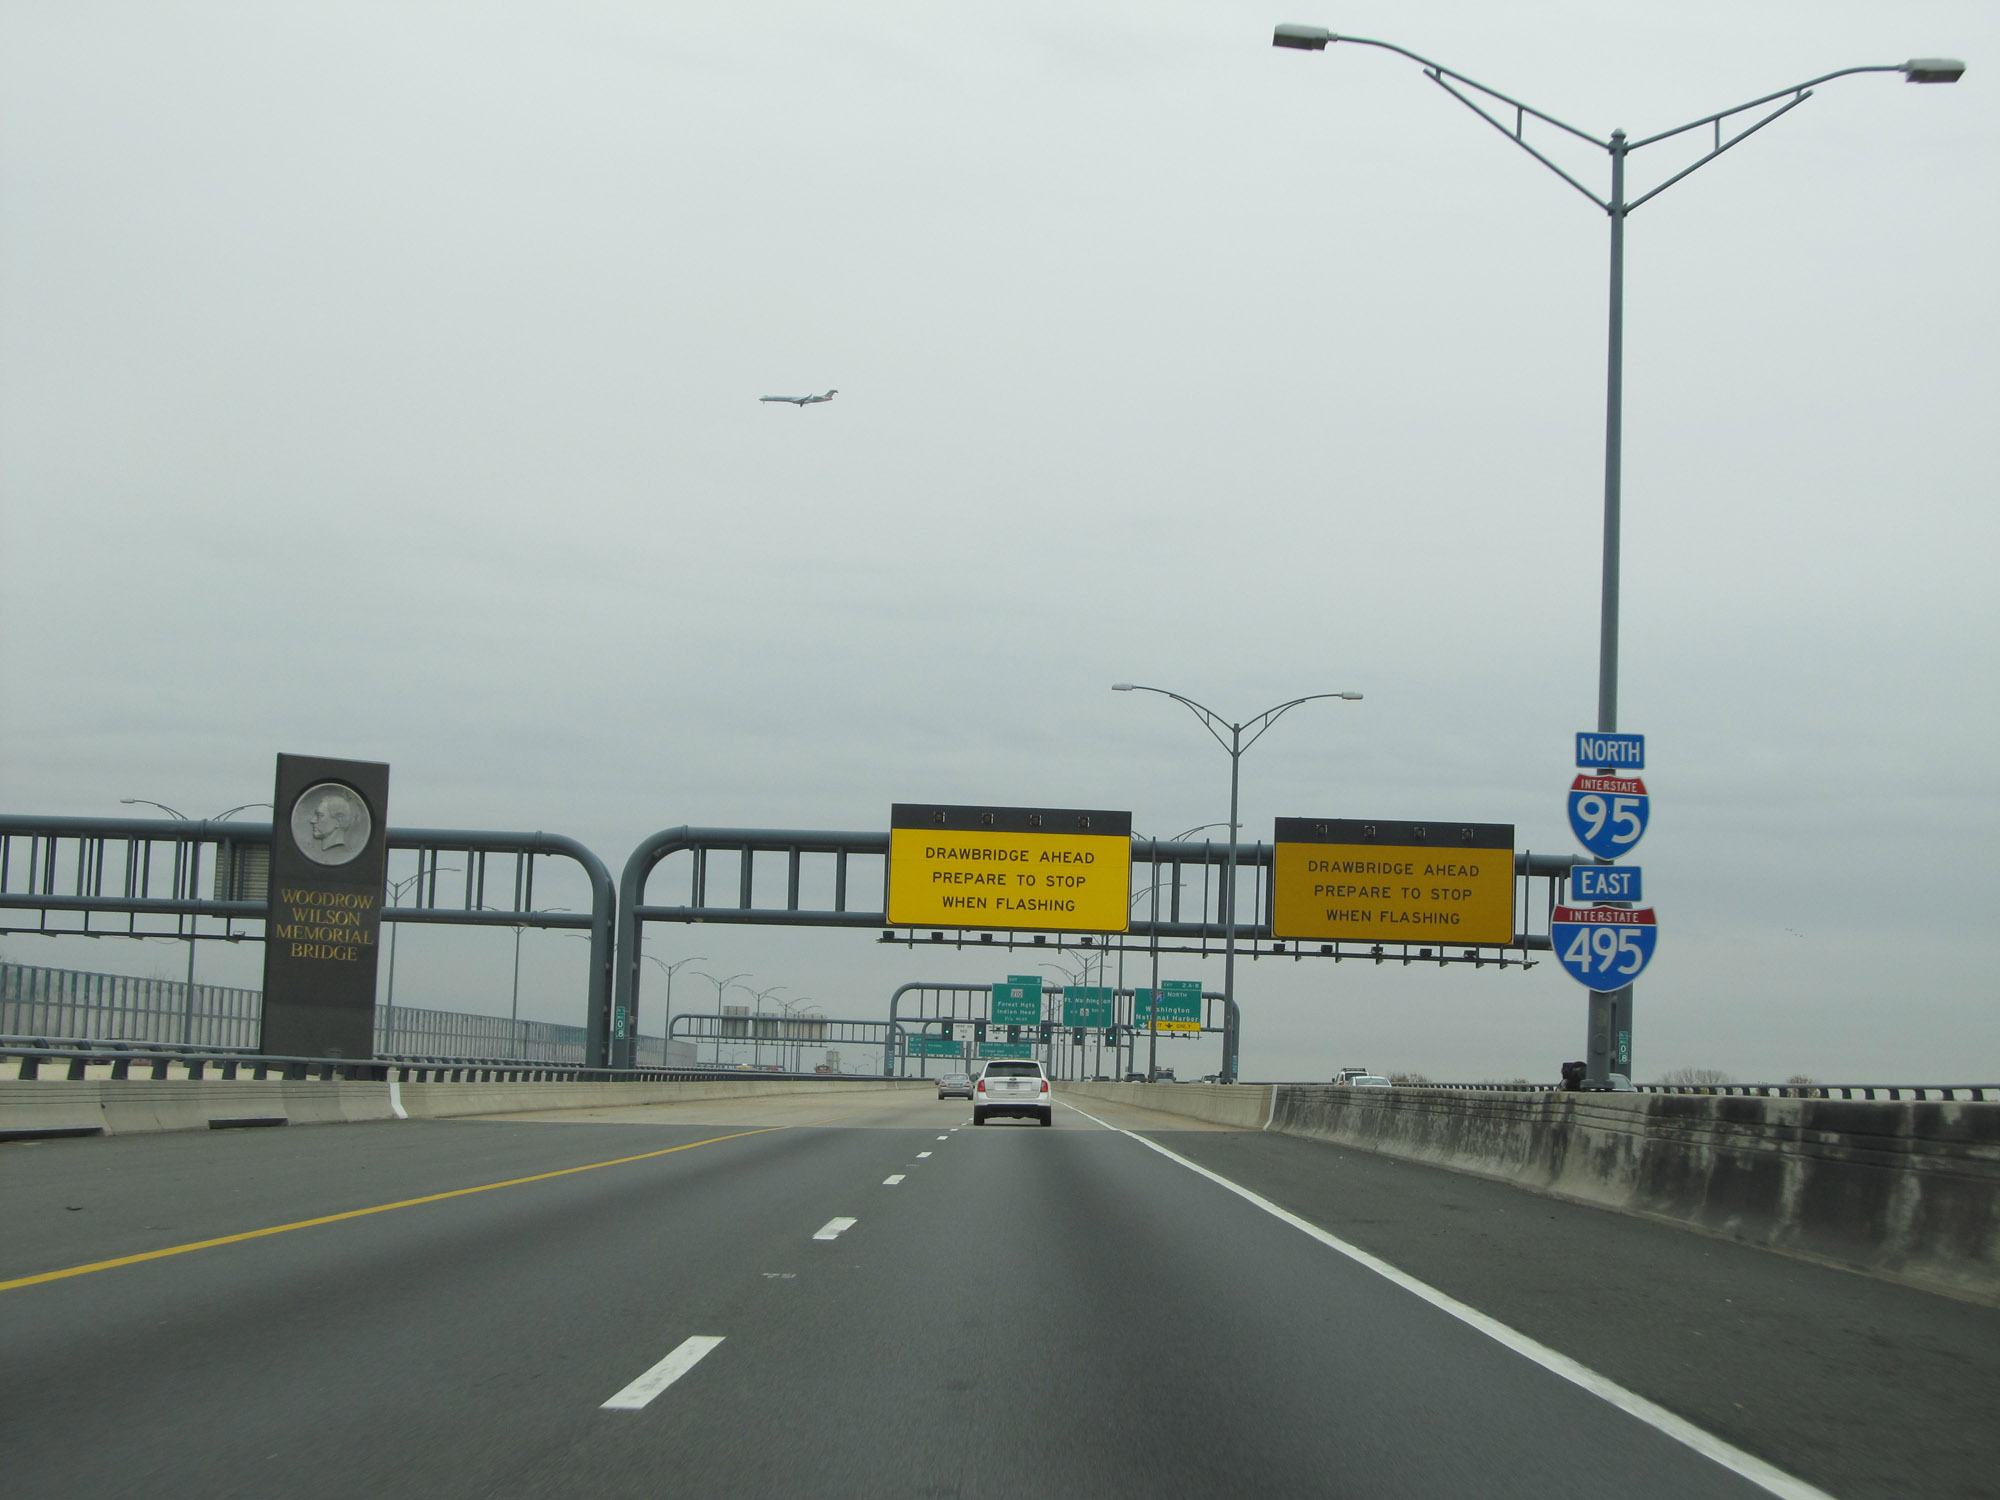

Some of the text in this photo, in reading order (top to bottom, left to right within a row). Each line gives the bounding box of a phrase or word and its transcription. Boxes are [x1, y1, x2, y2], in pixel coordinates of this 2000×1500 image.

[1580, 738, 1640, 762] NORTH
[1581, 779, 1638, 793] INTERSTATE
[1577, 795, 1641, 844] 95
[925, 847, 1095, 864] DRAWBRIDGE AHEAD
[1308, 860, 1480, 877] DRAWBRIDGE AHEAD
[932, 872, 1086, 888] PREPARE TO STOP
[1581, 871, 1631, 894] EAST
[281, 888, 374, 909] WOODROW
[1314, 885, 1473, 901] PREPARE TO STOP
[942, 896, 1076, 912] WHEN FLASHING
[292, 907, 360, 926] WILSON
[1326, 909, 1461, 925] WHEN FLASHING
[1569, 910, 1639, 922] INTERSTATE
[276, 923, 374, 945] MEMORIAL
[291, 942, 358, 961] BRIDGE
[1563, 927, 1643, 975] 495
[1146, 1006, 1190, 1014] Wshington
